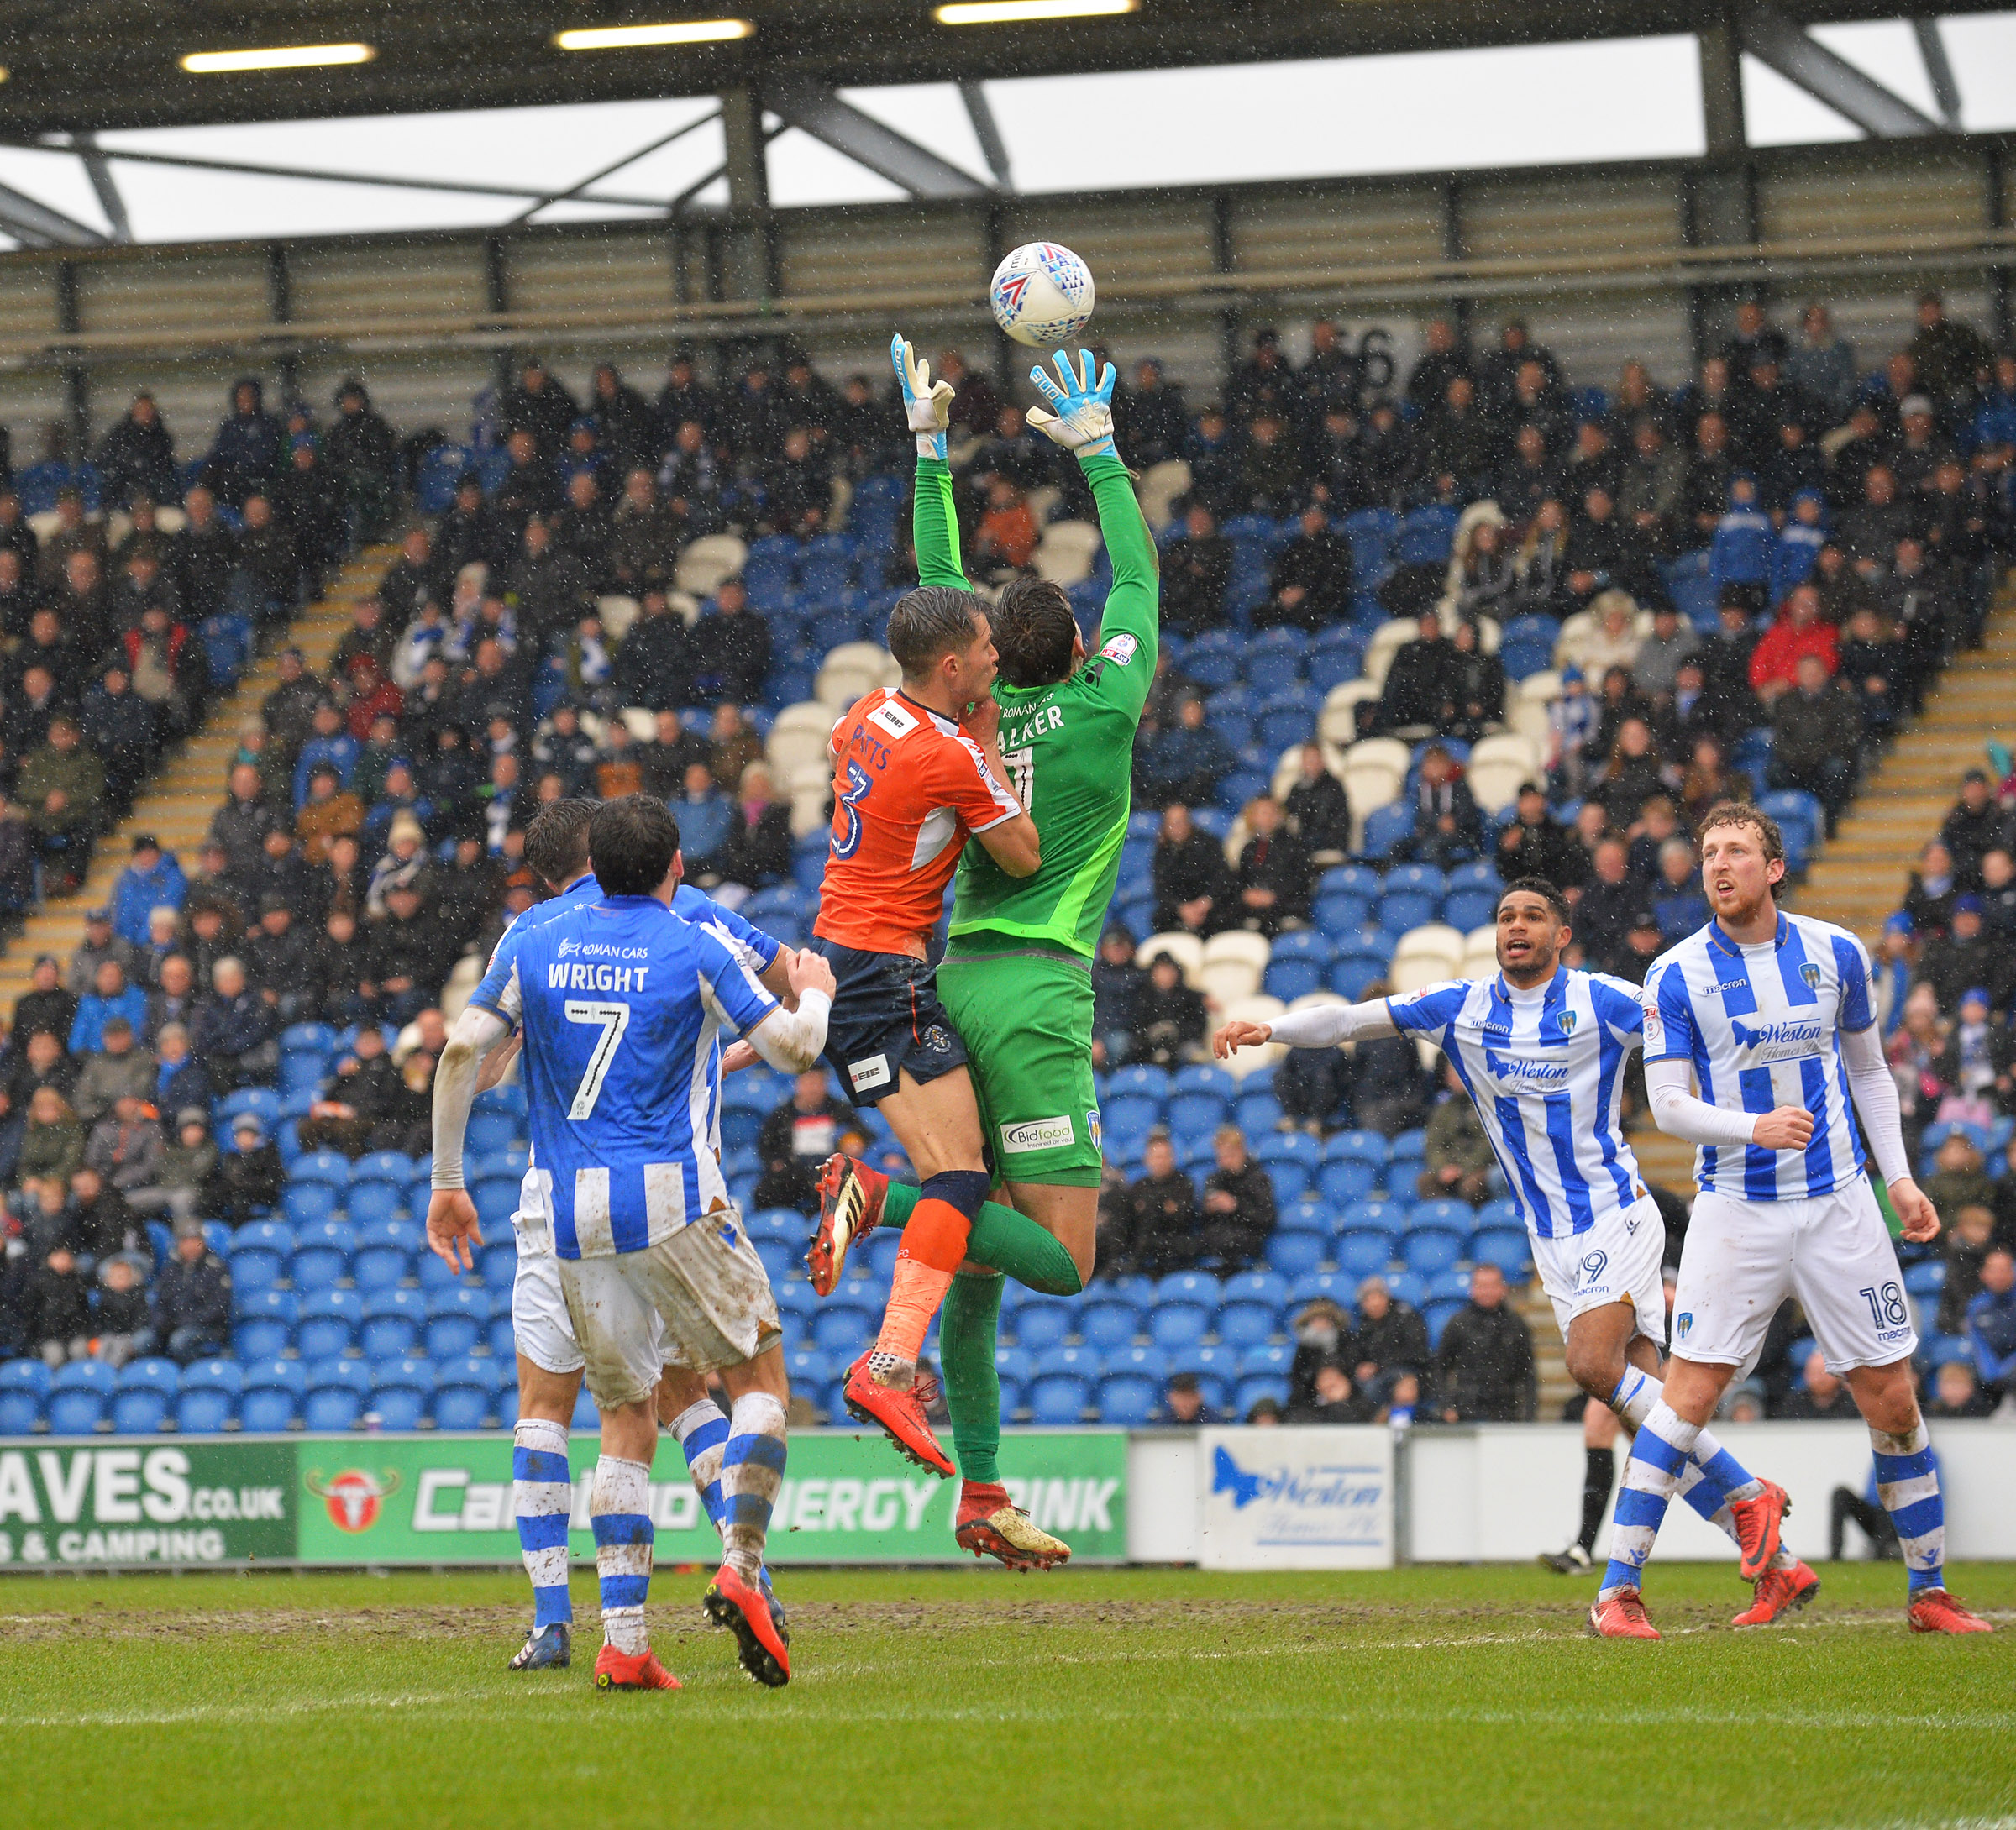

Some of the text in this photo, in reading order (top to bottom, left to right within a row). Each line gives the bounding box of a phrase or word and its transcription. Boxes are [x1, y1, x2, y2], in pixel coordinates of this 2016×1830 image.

[1002, 702, 1037, 719] ROMAN
[997, 705, 1065, 752] ALKER
[832, 757, 874, 861] 3
[581, 943, 649, 959] ROMAN CARS
[548, 962, 649, 993] WRIGHT
[1703, 978, 1747, 994] macron
[1471, 1020, 1509, 1034] macron
[1759, 1021, 1823, 1045] Weston
[564, 999, 630, 1120] 7
[1508, 1059, 1570, 1079] Weston
[1017, 1123, 1071, 1143] Bidfood
[1859, 1282, 1907, 1329] 18
[57, 1528, 226, 1564] CAMPING
